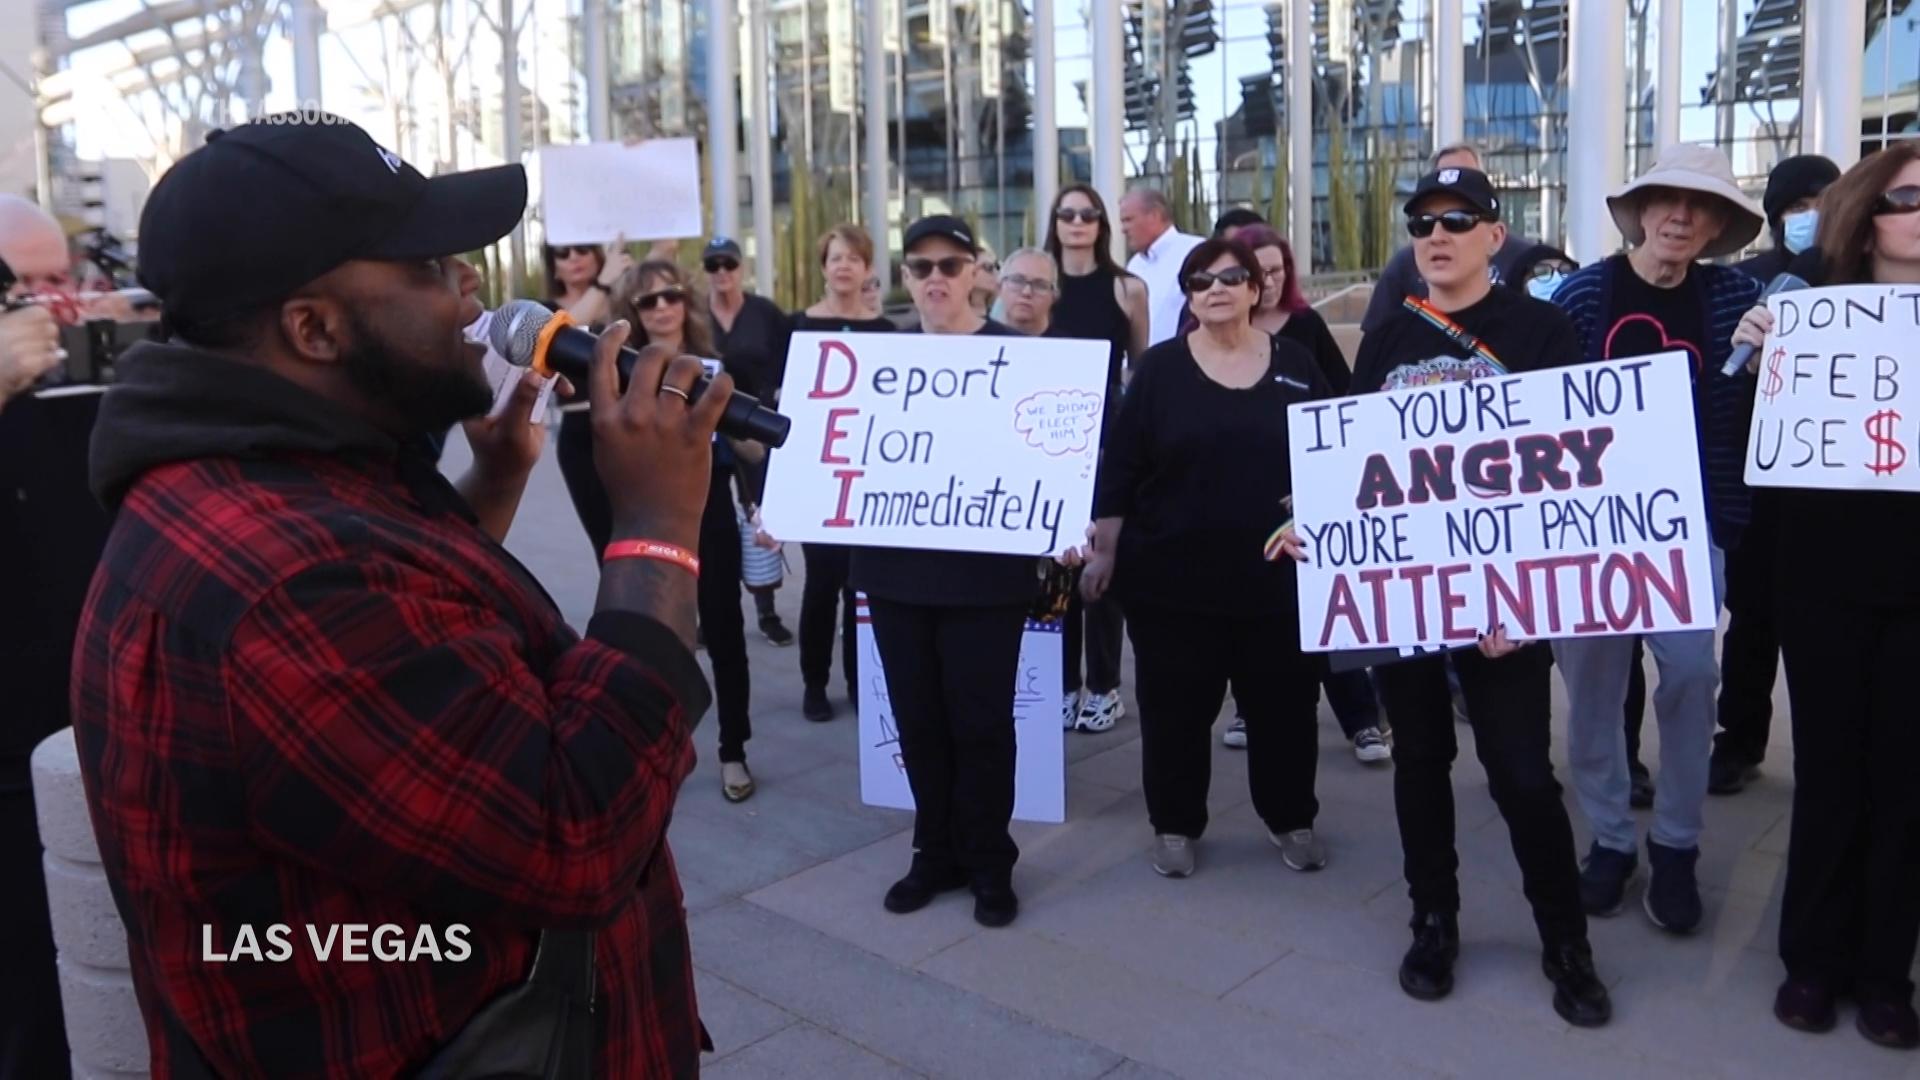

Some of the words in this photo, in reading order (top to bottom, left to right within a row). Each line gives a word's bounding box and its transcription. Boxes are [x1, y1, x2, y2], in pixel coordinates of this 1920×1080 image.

[1775, 288, 1920, 338] DON'T
[807, 340, 1010, 412] Deport
[1301, 400, 1359, 453] IF
[1388, 378, 1531, 441] YOU'RE
[1562, 362, 1652, 421] NOT
[820, 408, 934, 466] Elon
[1027, 405, 1046, 416] WE
[1039, 416, 1078, 429] ELECT
[1050, 428, 1076, 440] HIM
[1355, 427, 1614, 511] ANGRY
[1756, 418, 1847, 471] USE
[822, 470, 1064, 556] Immediately
[1303, 511, 1414, 569] YOU'RE
[1446, 503, 1524, 557] NOT
[1540, 488, 1689, 551] PAYING
[1319, 548, 1693, 647] ATTENTION
